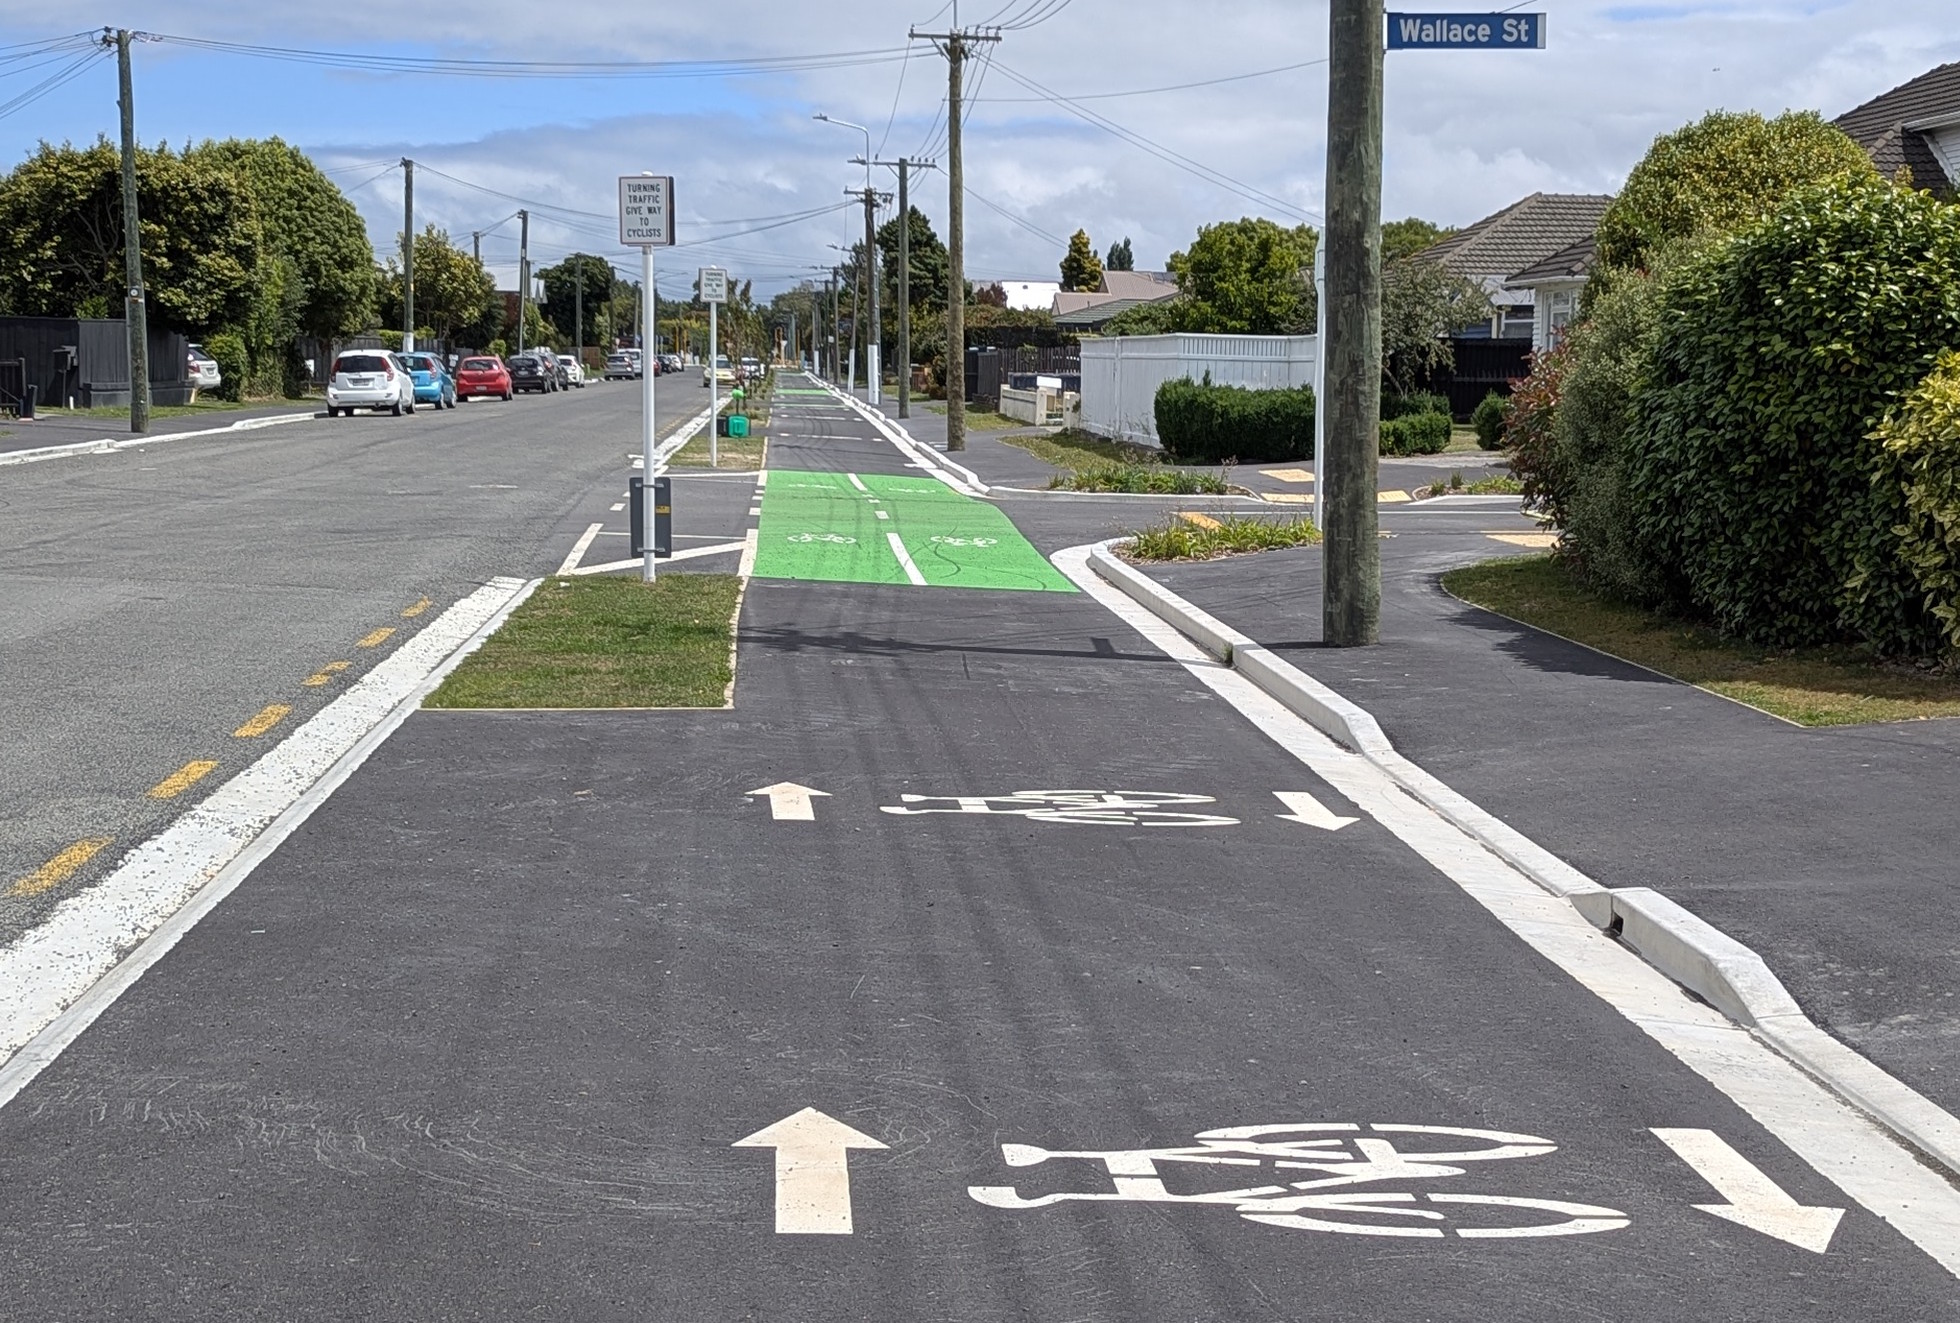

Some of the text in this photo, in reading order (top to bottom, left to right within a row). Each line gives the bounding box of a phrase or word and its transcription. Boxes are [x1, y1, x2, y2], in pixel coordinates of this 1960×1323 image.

[1400, 18, 1529, 42] Wallace St
[627, 183, 661, 192] TURNING
[628, 195, 660, 204] TRAFFIC
[625, 206, 662, 215] GIVE WAY
[639, 217, 649, 226] TO
[627, 228, 662, 238] CYCLISTS
